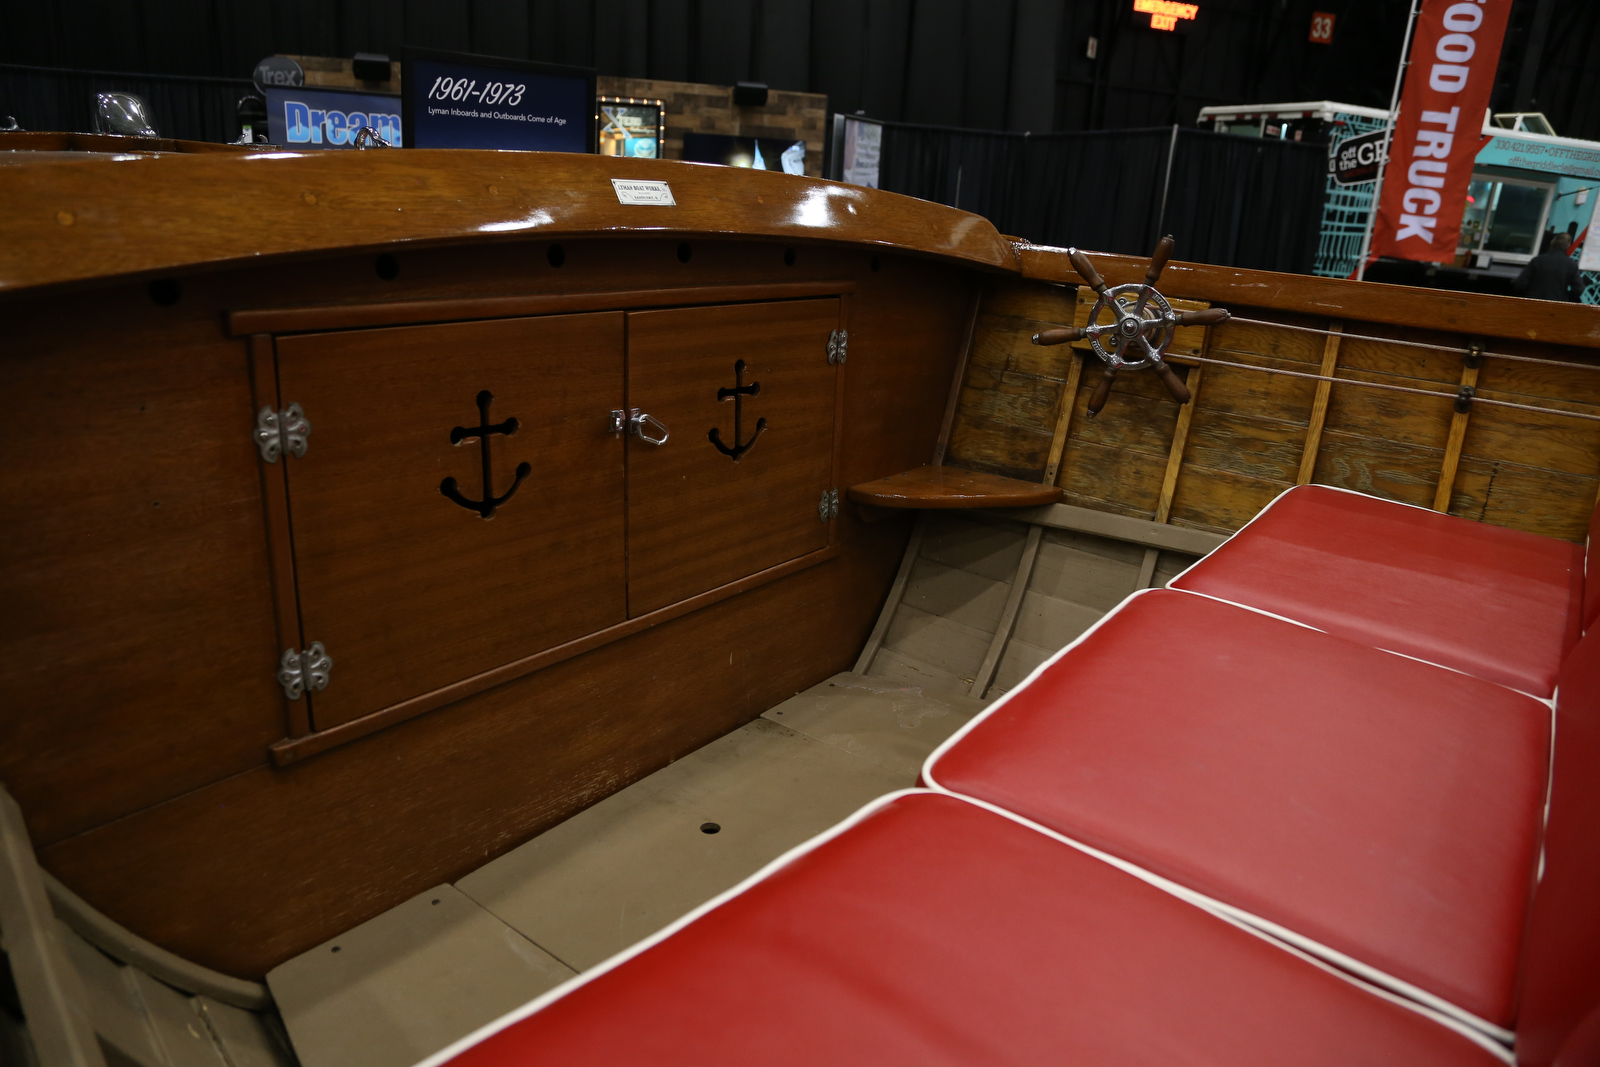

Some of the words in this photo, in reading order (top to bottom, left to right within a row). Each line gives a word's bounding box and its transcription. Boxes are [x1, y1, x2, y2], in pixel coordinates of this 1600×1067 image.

[1150, 13, 1178, 31] EXIT
[1312, 17, 1332, 39] 33
[1429, 0, 1486, 93] OOD
[260, 65, 298, 86] Trex
[428, 76, 526, 106] 1961-1973
[284, 101, 402, 148] Dream
[428, 106, 449, 116] Lyman
[450, 108, 479, 118] Inboards
[480, 110, 492, 119] and
[493, 111, 526, 122] Outboards
[527, 114, 545, 123] Come
[546, 116, 553, 124] of
[553, 117, 567, 126] Age
[1339, 159, 1358, 171] the
[1395, 106, 1460, 244] TRUCK
